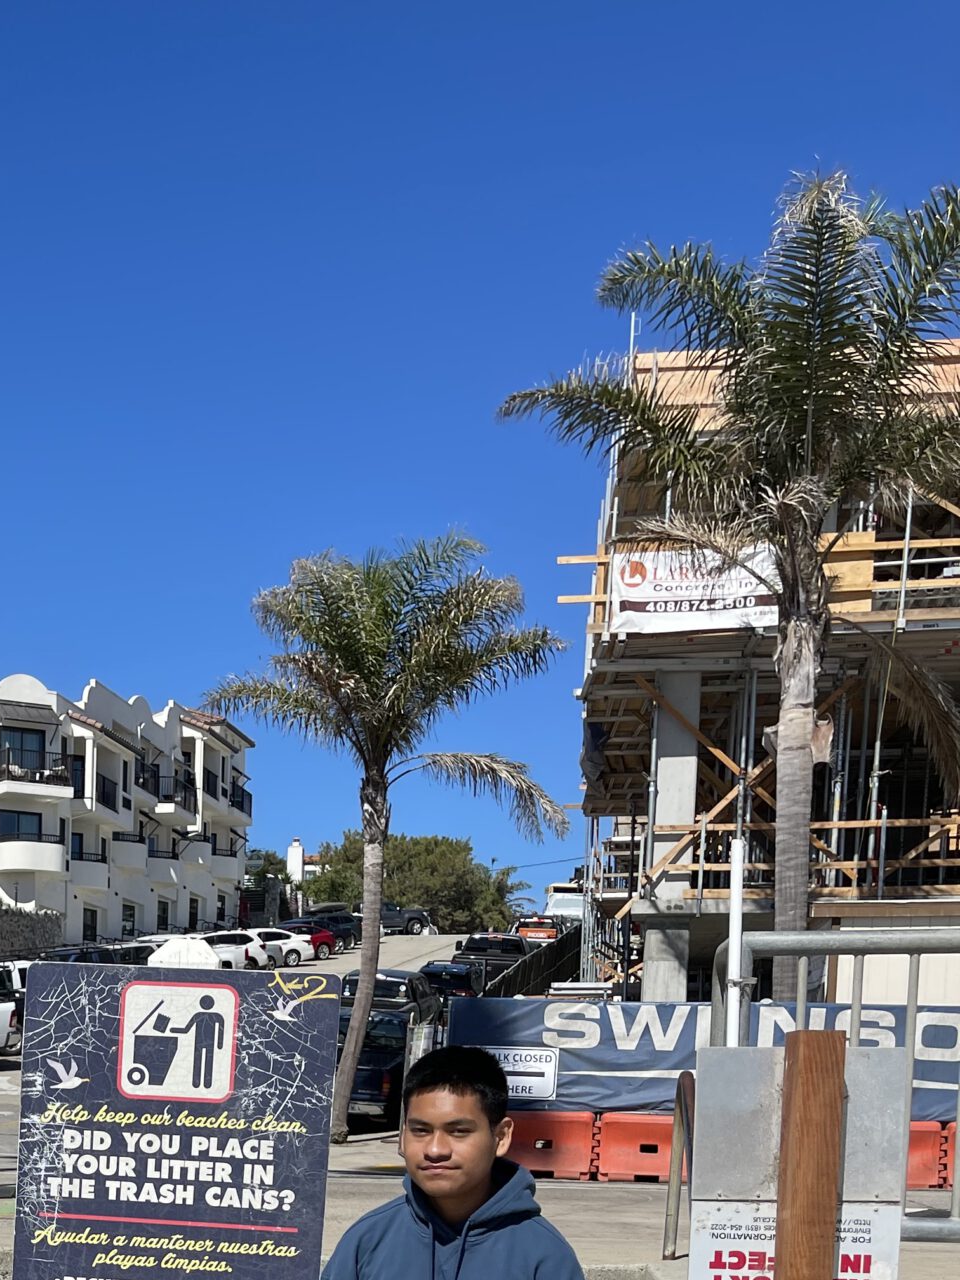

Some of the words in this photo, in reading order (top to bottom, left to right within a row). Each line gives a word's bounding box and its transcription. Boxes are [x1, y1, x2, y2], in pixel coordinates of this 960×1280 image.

[512, 1053, 552, 1063] CLOSED
[41, 1102, 91, 1123] Help
[94, 1105, 137, 1125] keep
[141, 1112, 173, 1126] our
[177, 1110, 248, 1130] beaches
[251, 1115, 307, 1133] clean.
[63, 1129, 112, 1150] DID
[122, 1132, 181, 1155] YOU
[191, 1136, 275, 1161] PLACE
[63, 1154, 136, 1177] YOUR
[146, 1158, 232, 1183] LITTER
[243, 1163, 274, 1186] IN
[47, 1177, 95, 1200] THE
[105, 1180, 194, 1206] TRASH
[205, 1186, 296, 1211] CANS?
[31, 1224, 110, 1246] Ayudar
[113, 1236, 128, 1247] a
[130, 1233, 215, 1254] mantener
[217, 1238, 301, 1258] nuestras
[851, 1236, 872, 1244] FOR
[92, 1249, 158, 1269] playas
[160, 1252, 233, 1274] limpias.
[840, 1254, 872, 1274] IN
